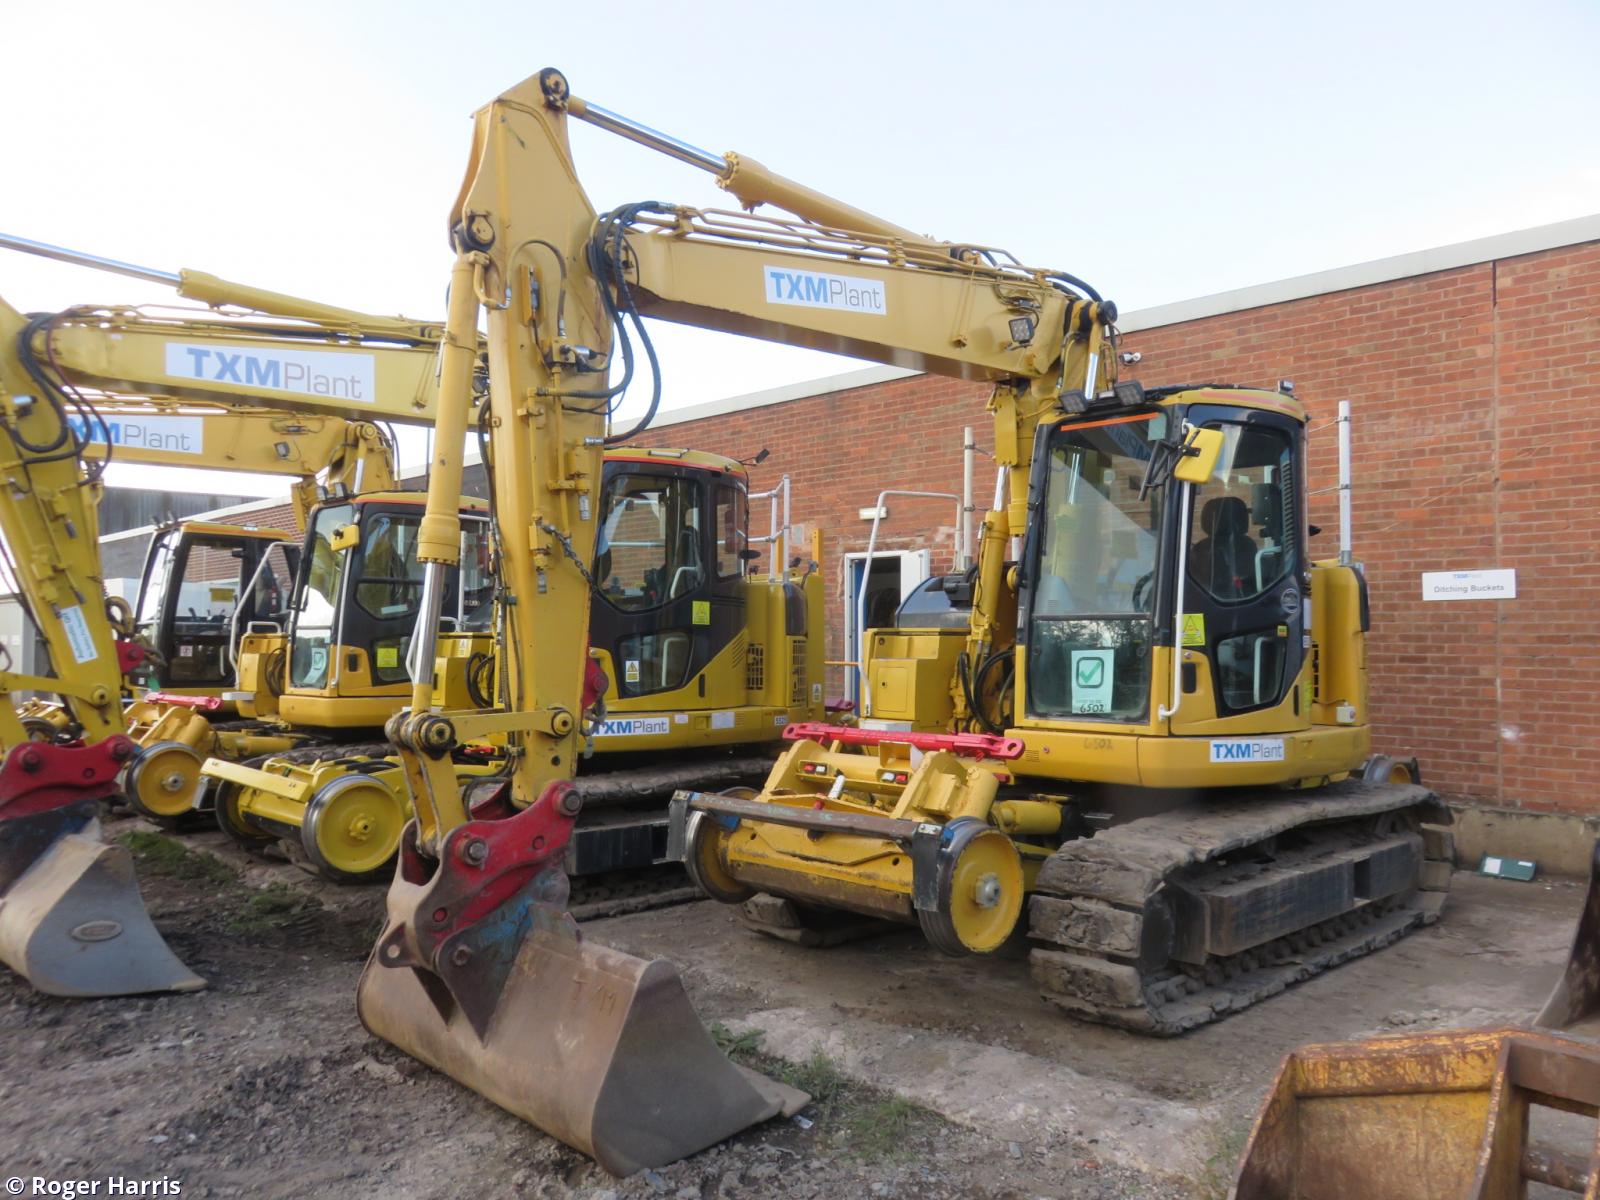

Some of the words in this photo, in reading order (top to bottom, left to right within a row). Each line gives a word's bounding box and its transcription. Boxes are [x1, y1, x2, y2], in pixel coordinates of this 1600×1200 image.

[770, 271, 881, 309] TXMPlant
[187, 347, 362, 399] TXMPlant
[1470, 584, 1504, 592] Buckets
[1213, 743, 1283, 759] TXMPlant
